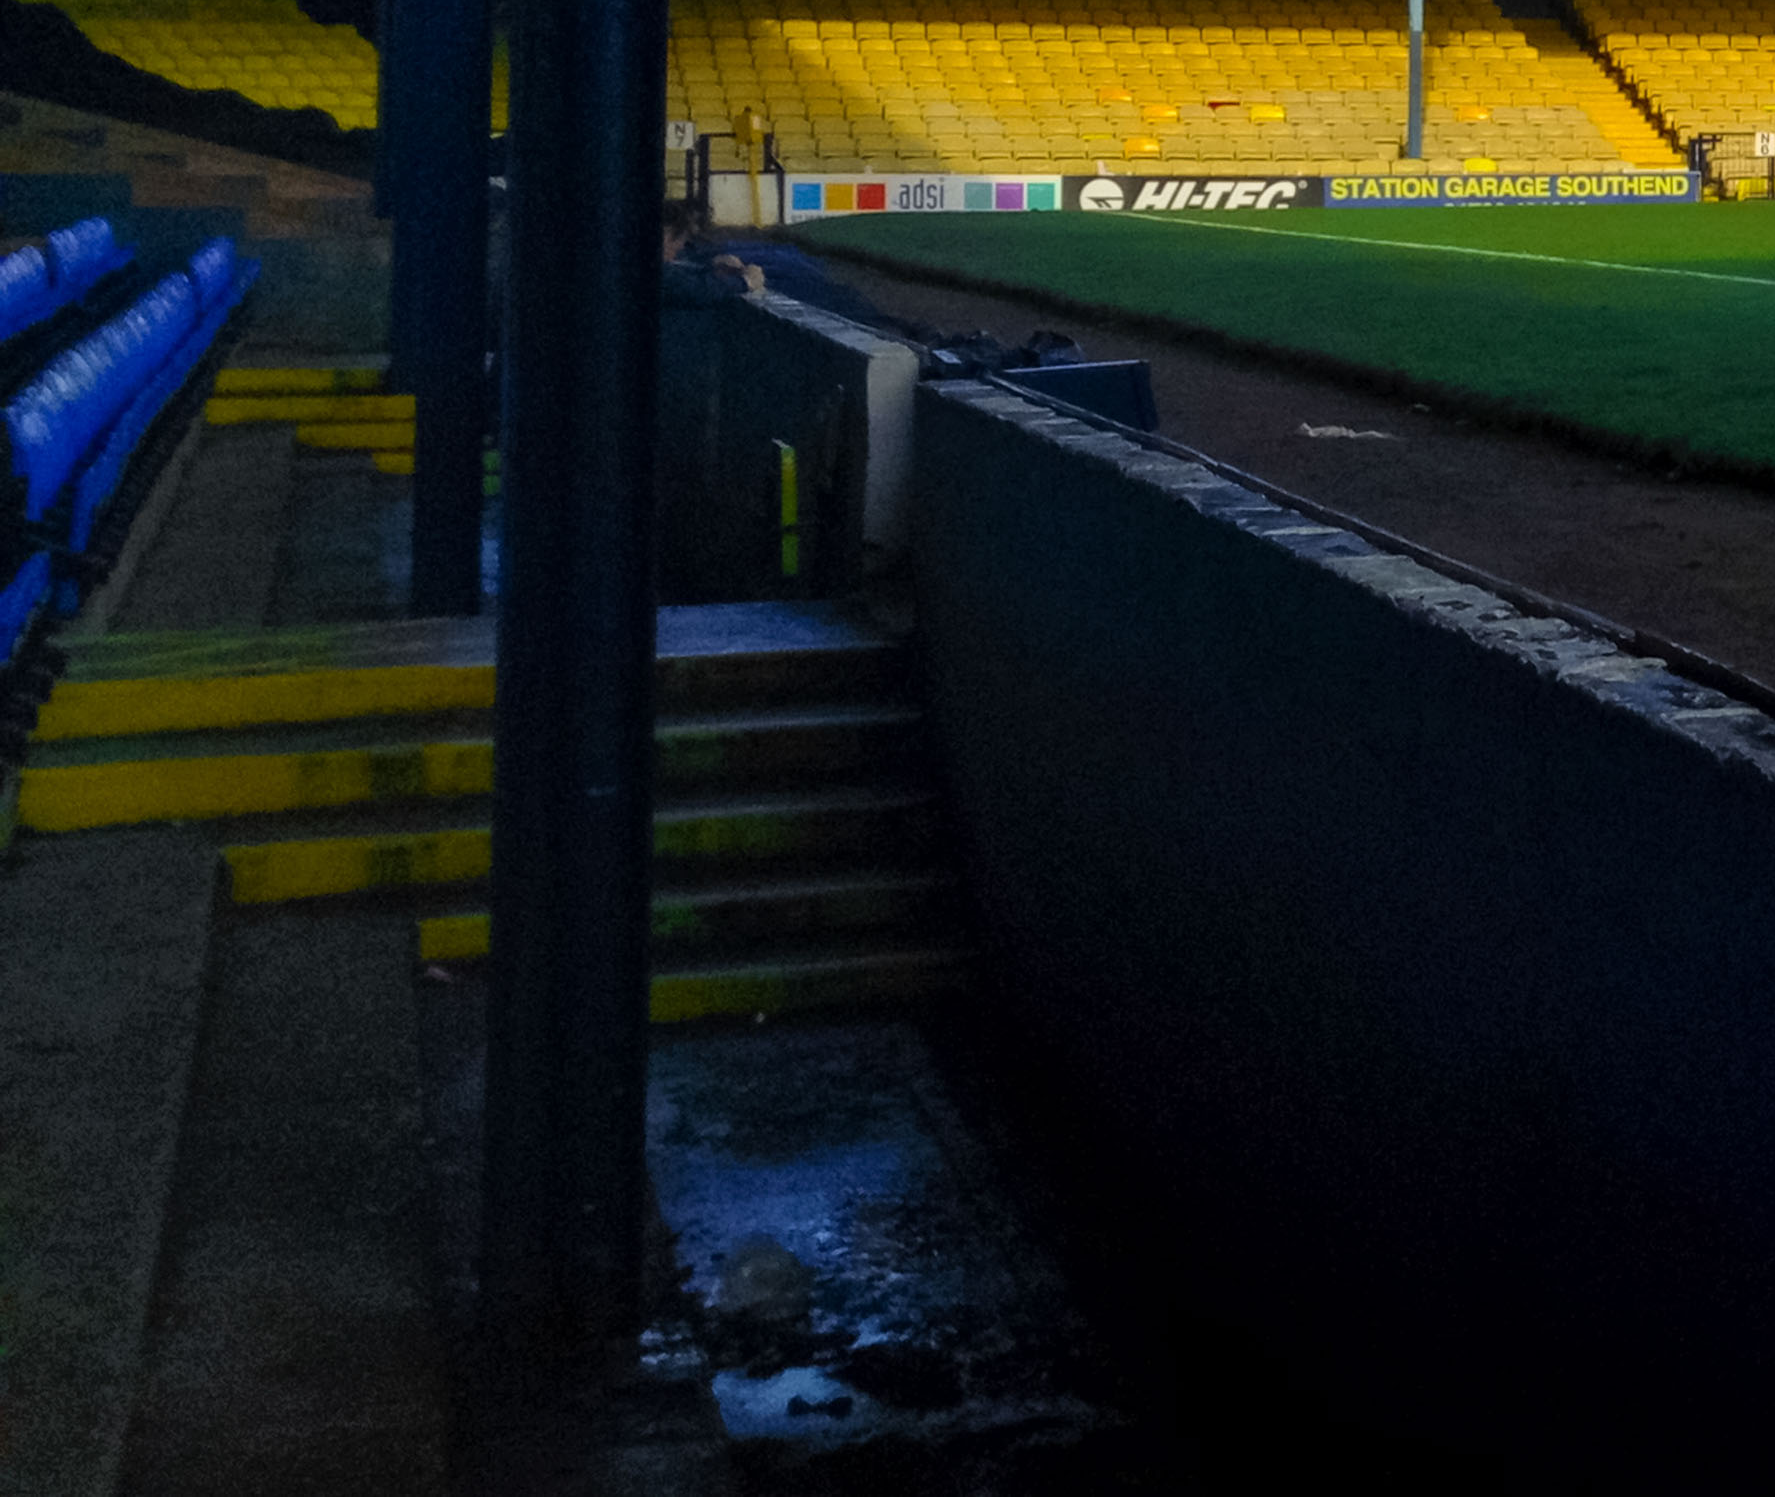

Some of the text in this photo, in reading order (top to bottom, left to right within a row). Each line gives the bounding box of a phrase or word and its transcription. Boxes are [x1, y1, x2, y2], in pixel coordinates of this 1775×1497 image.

[900, 177, 944, 210] adsi
[1330, 175, 1690, 199] STATION GARAGE SOUTHEND
